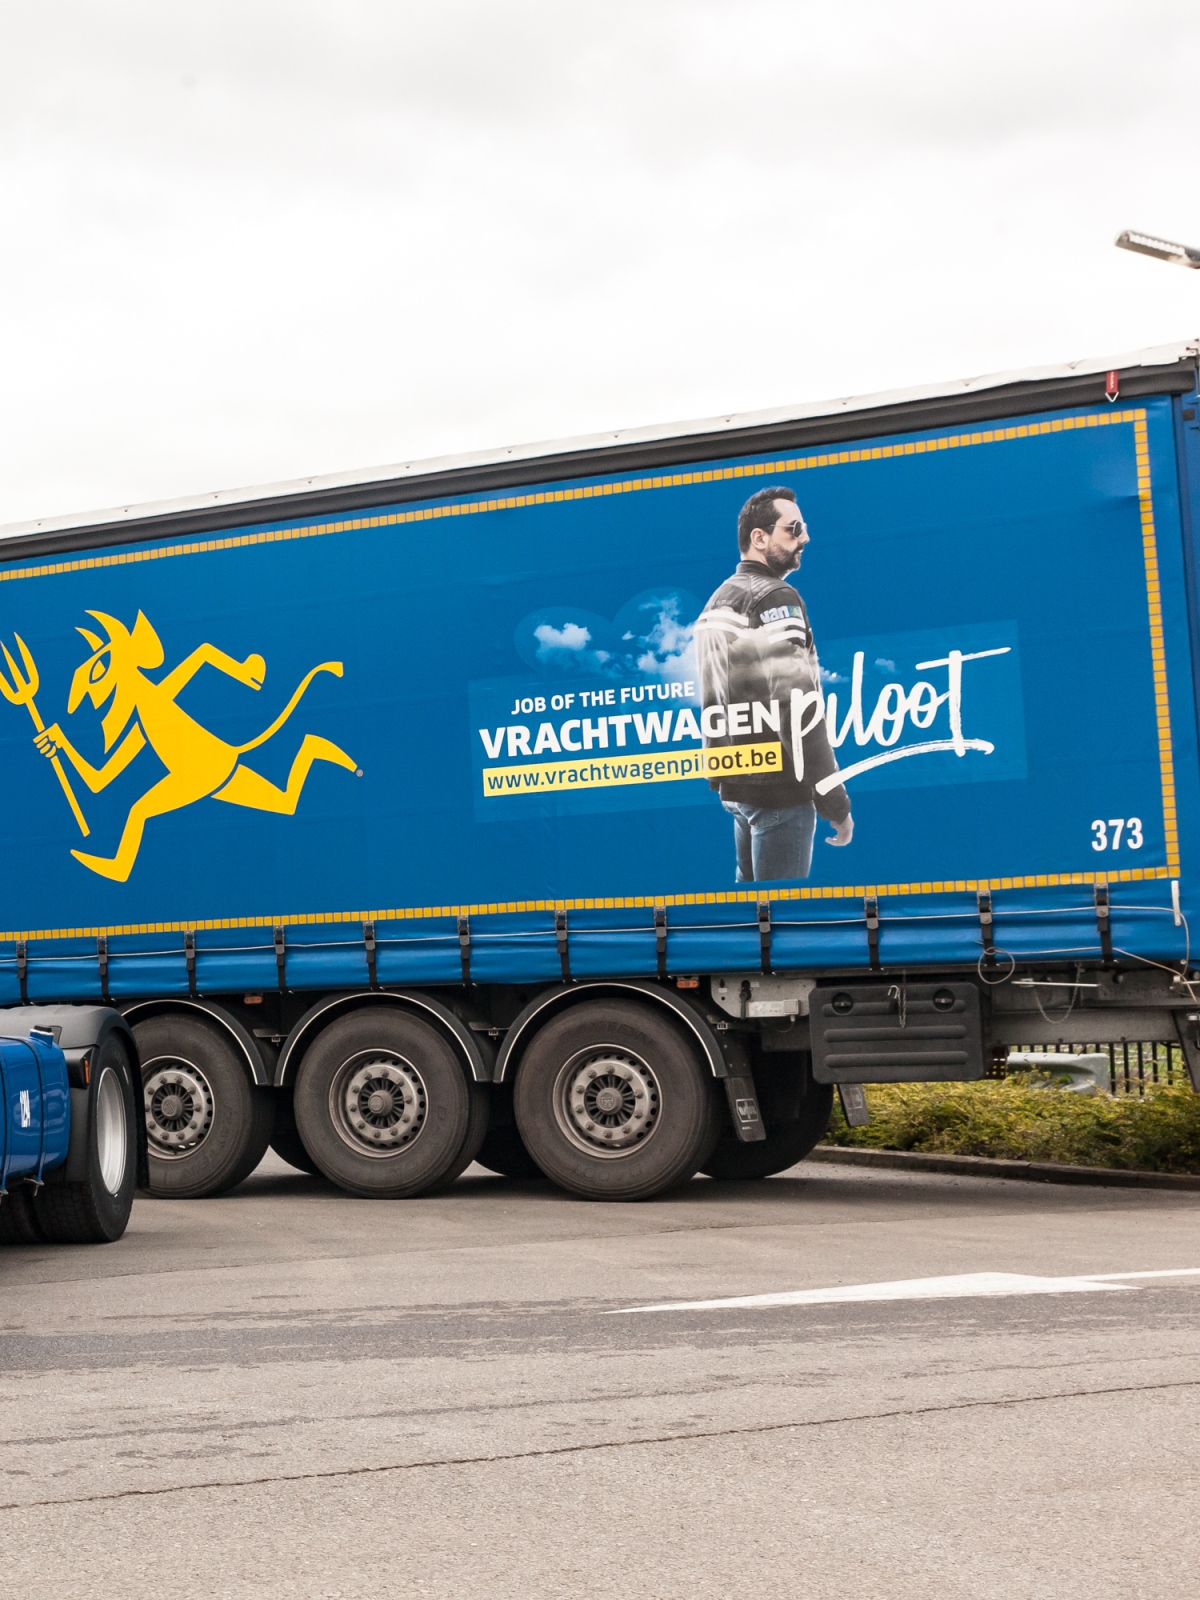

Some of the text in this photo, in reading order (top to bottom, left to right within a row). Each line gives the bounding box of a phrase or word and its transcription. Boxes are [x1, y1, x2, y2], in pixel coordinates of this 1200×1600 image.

[479, 647, 1011, 783] VRACHTWAGEN piloot
[511, 680, 696, 715] JOB OF THE FUTURE
[487, 748, 777, 790] www.vrachtwagenpiloot.be
[1091, 817, 1144, 851] 373
